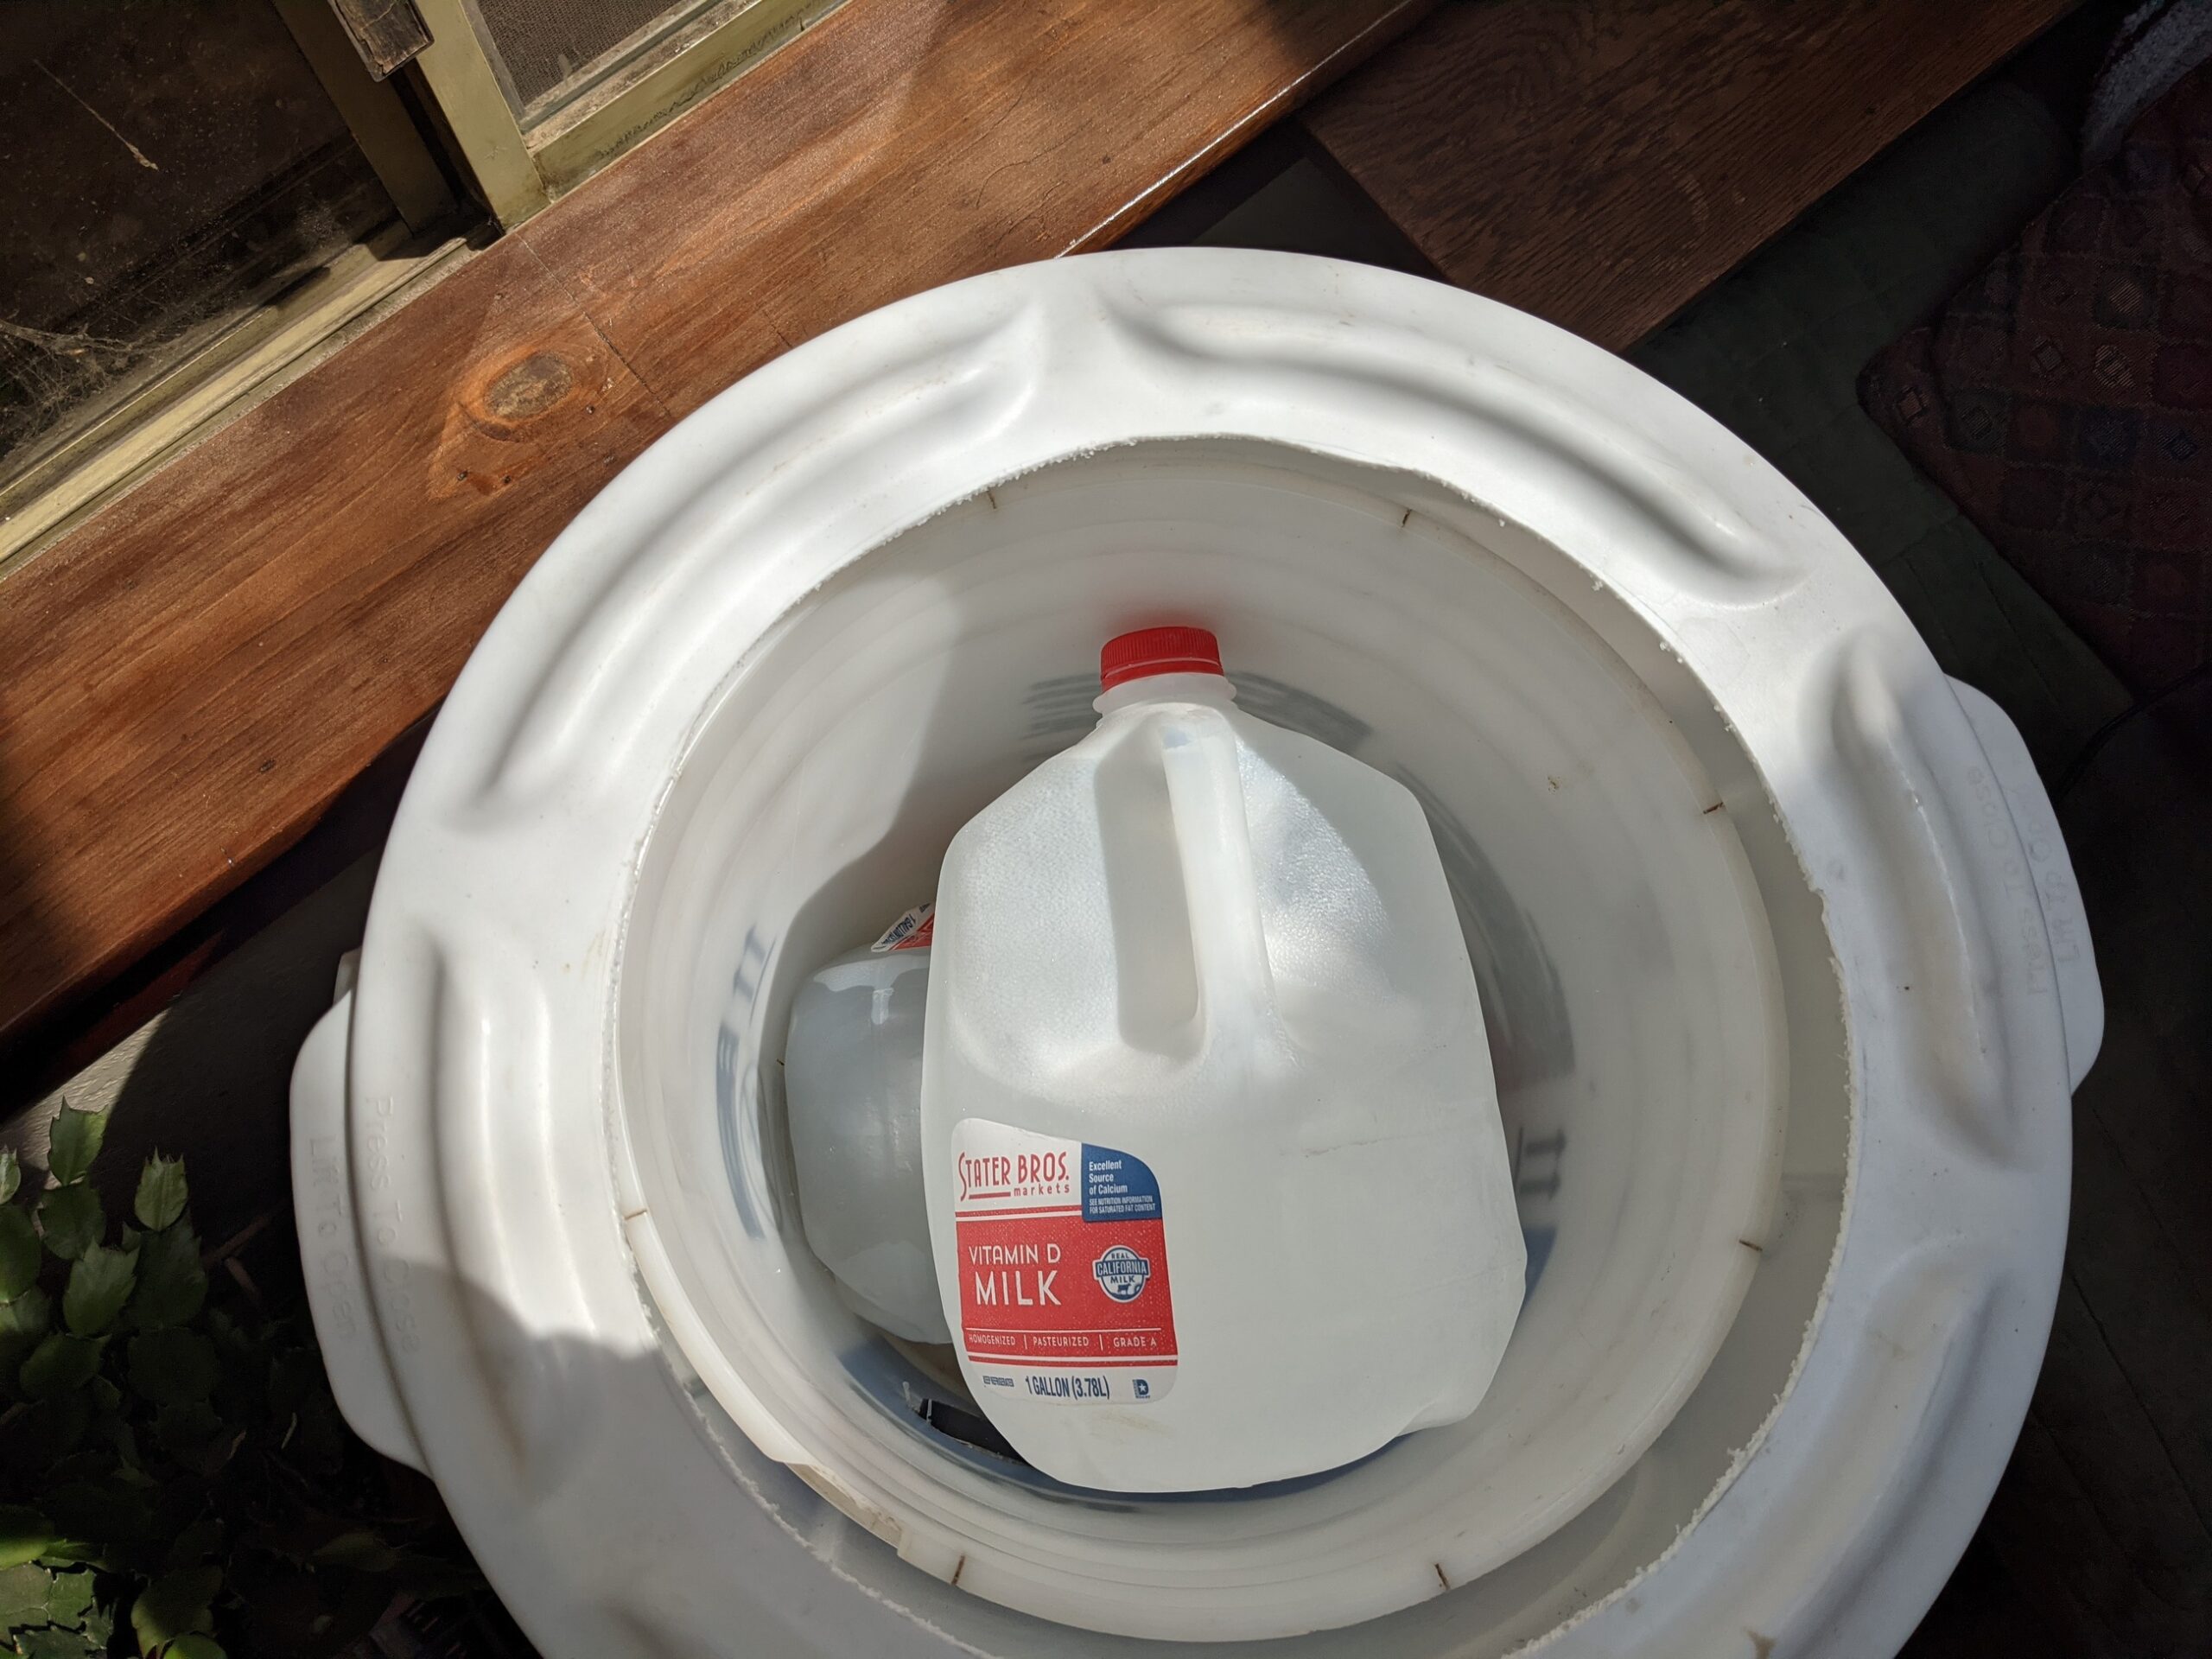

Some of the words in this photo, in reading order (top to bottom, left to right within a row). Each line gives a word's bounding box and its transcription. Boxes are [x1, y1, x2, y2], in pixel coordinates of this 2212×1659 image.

[366, 1096, 394, 1191] Press
[1089, 1160, 1122, 1171] Excellent
[958, 1152, 1011, 1202] STATER
[1018, 1151, 1070, 1184] BROS.
[1089, 1173, 1114, 1183] Source
[1014, 1184, 1070, 1197] markets
[1089, 1185, 1096, 1195] of
[1098, 1184, 1128, 1194] Calcium
[1097, 1197, 1122, 1205] NUTRITION
[1122, 1195, 1153, 1204] INFORMATION
[1098, 1205, 1124, 1214] SATURATED
[1125, 1204, 1134, 1212] FAT
[1135, 1203, 1156, 1211] CONTENT
[373, 1198, 403, 1245] To
[968, 1243, 1039, 1265] VITAMIN
[1046, 1243, 1061, 1263] D
[1096, 1261, 1147, 1275] CALIFORNIA
[975, 1270, 1062, 1306] MILK
[969, 1333, 1016, 1345] HOMOGENIZED
[1033, 1336, 1089, 1346] PASTEURIZED
[1113, 1337, 1146, 1347] GRADE
[1150, 1337, 1157, 1347] A
[1026, 1376, 1033, 1395] 1
[1033, 1376, 1071, 1398] GALLON
[1071, 1376, 1109, 1400] (3.78L)
